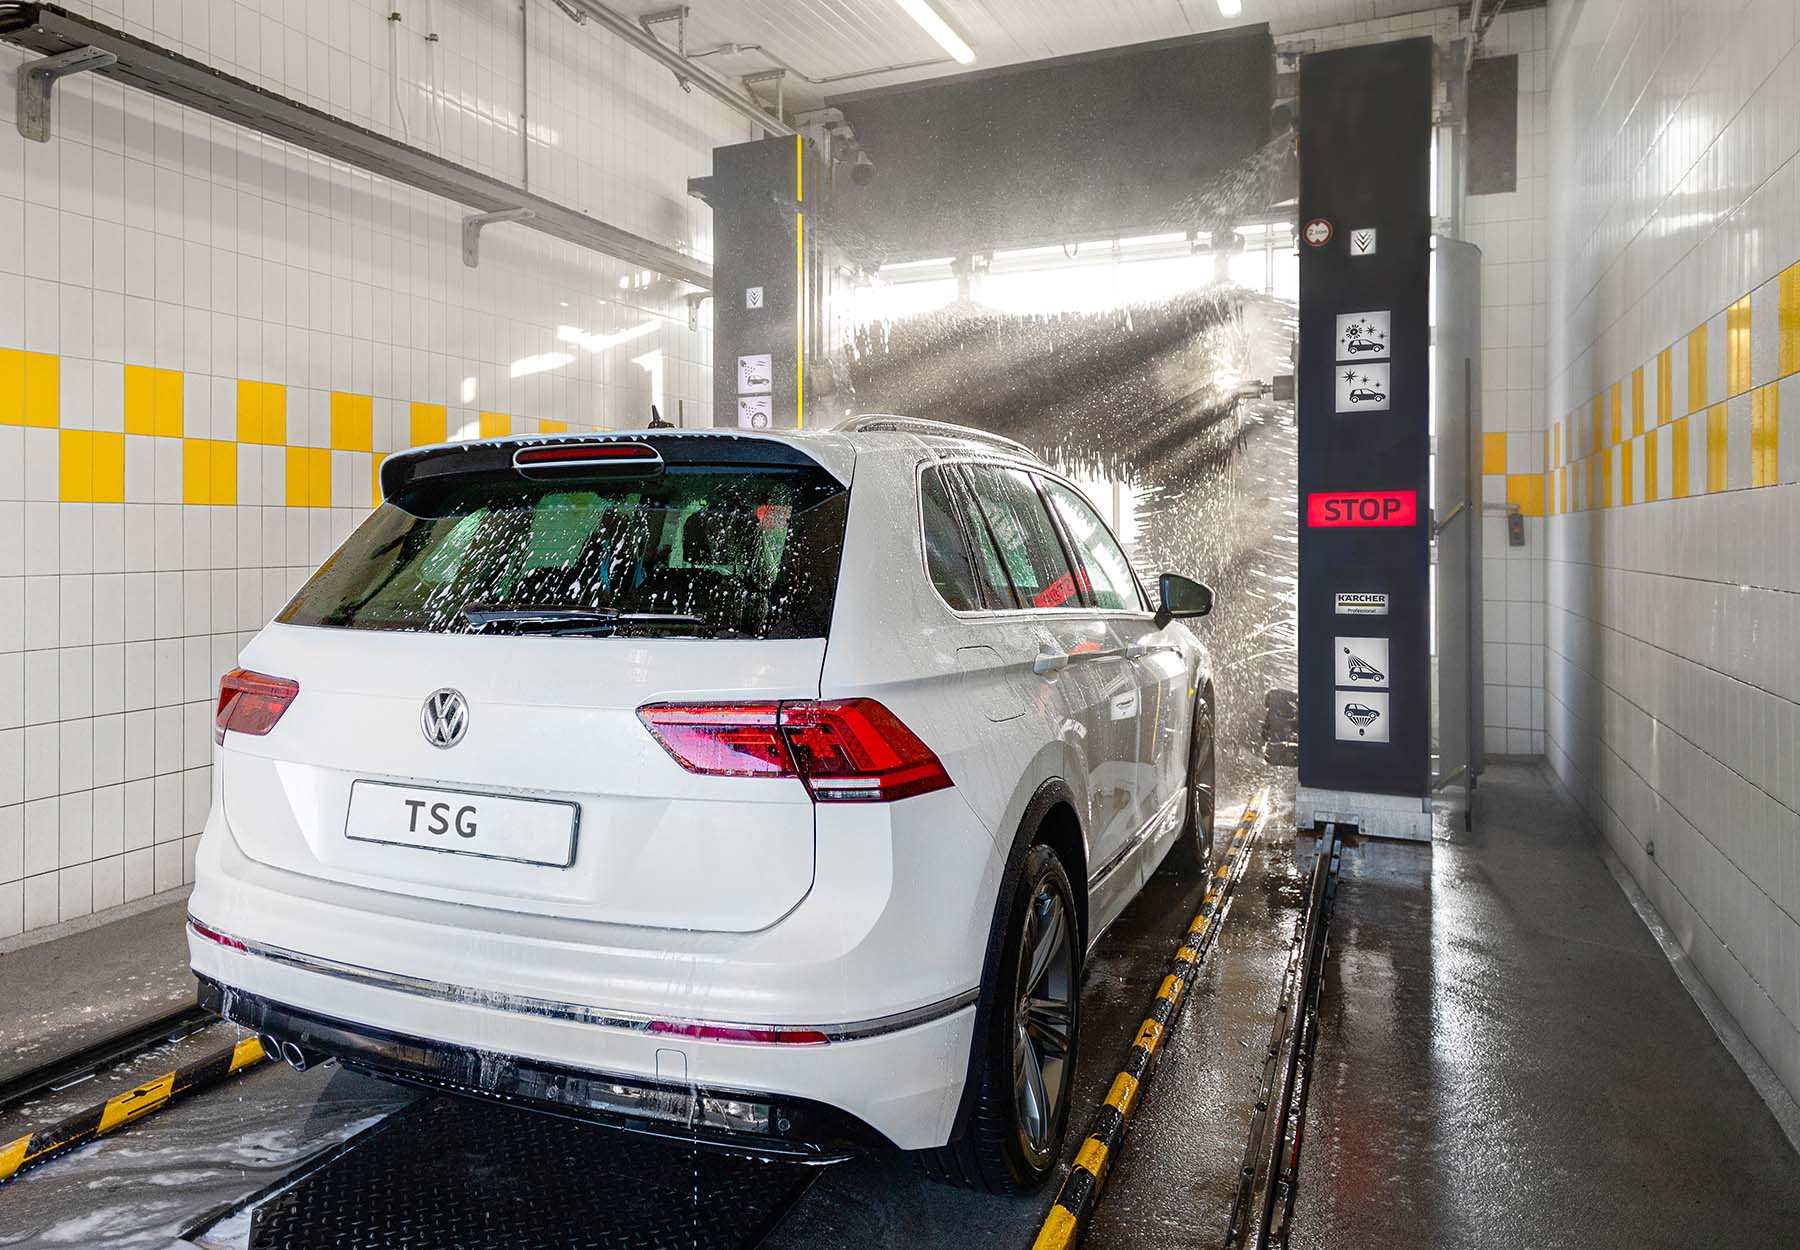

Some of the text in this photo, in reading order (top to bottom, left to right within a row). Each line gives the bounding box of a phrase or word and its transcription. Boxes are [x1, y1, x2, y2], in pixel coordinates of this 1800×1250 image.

[1325, 498, 1400, 521] STOP
[1338, 594, 1385, 602] KÄRCHER
[405, 799, 477, 838] TSG
